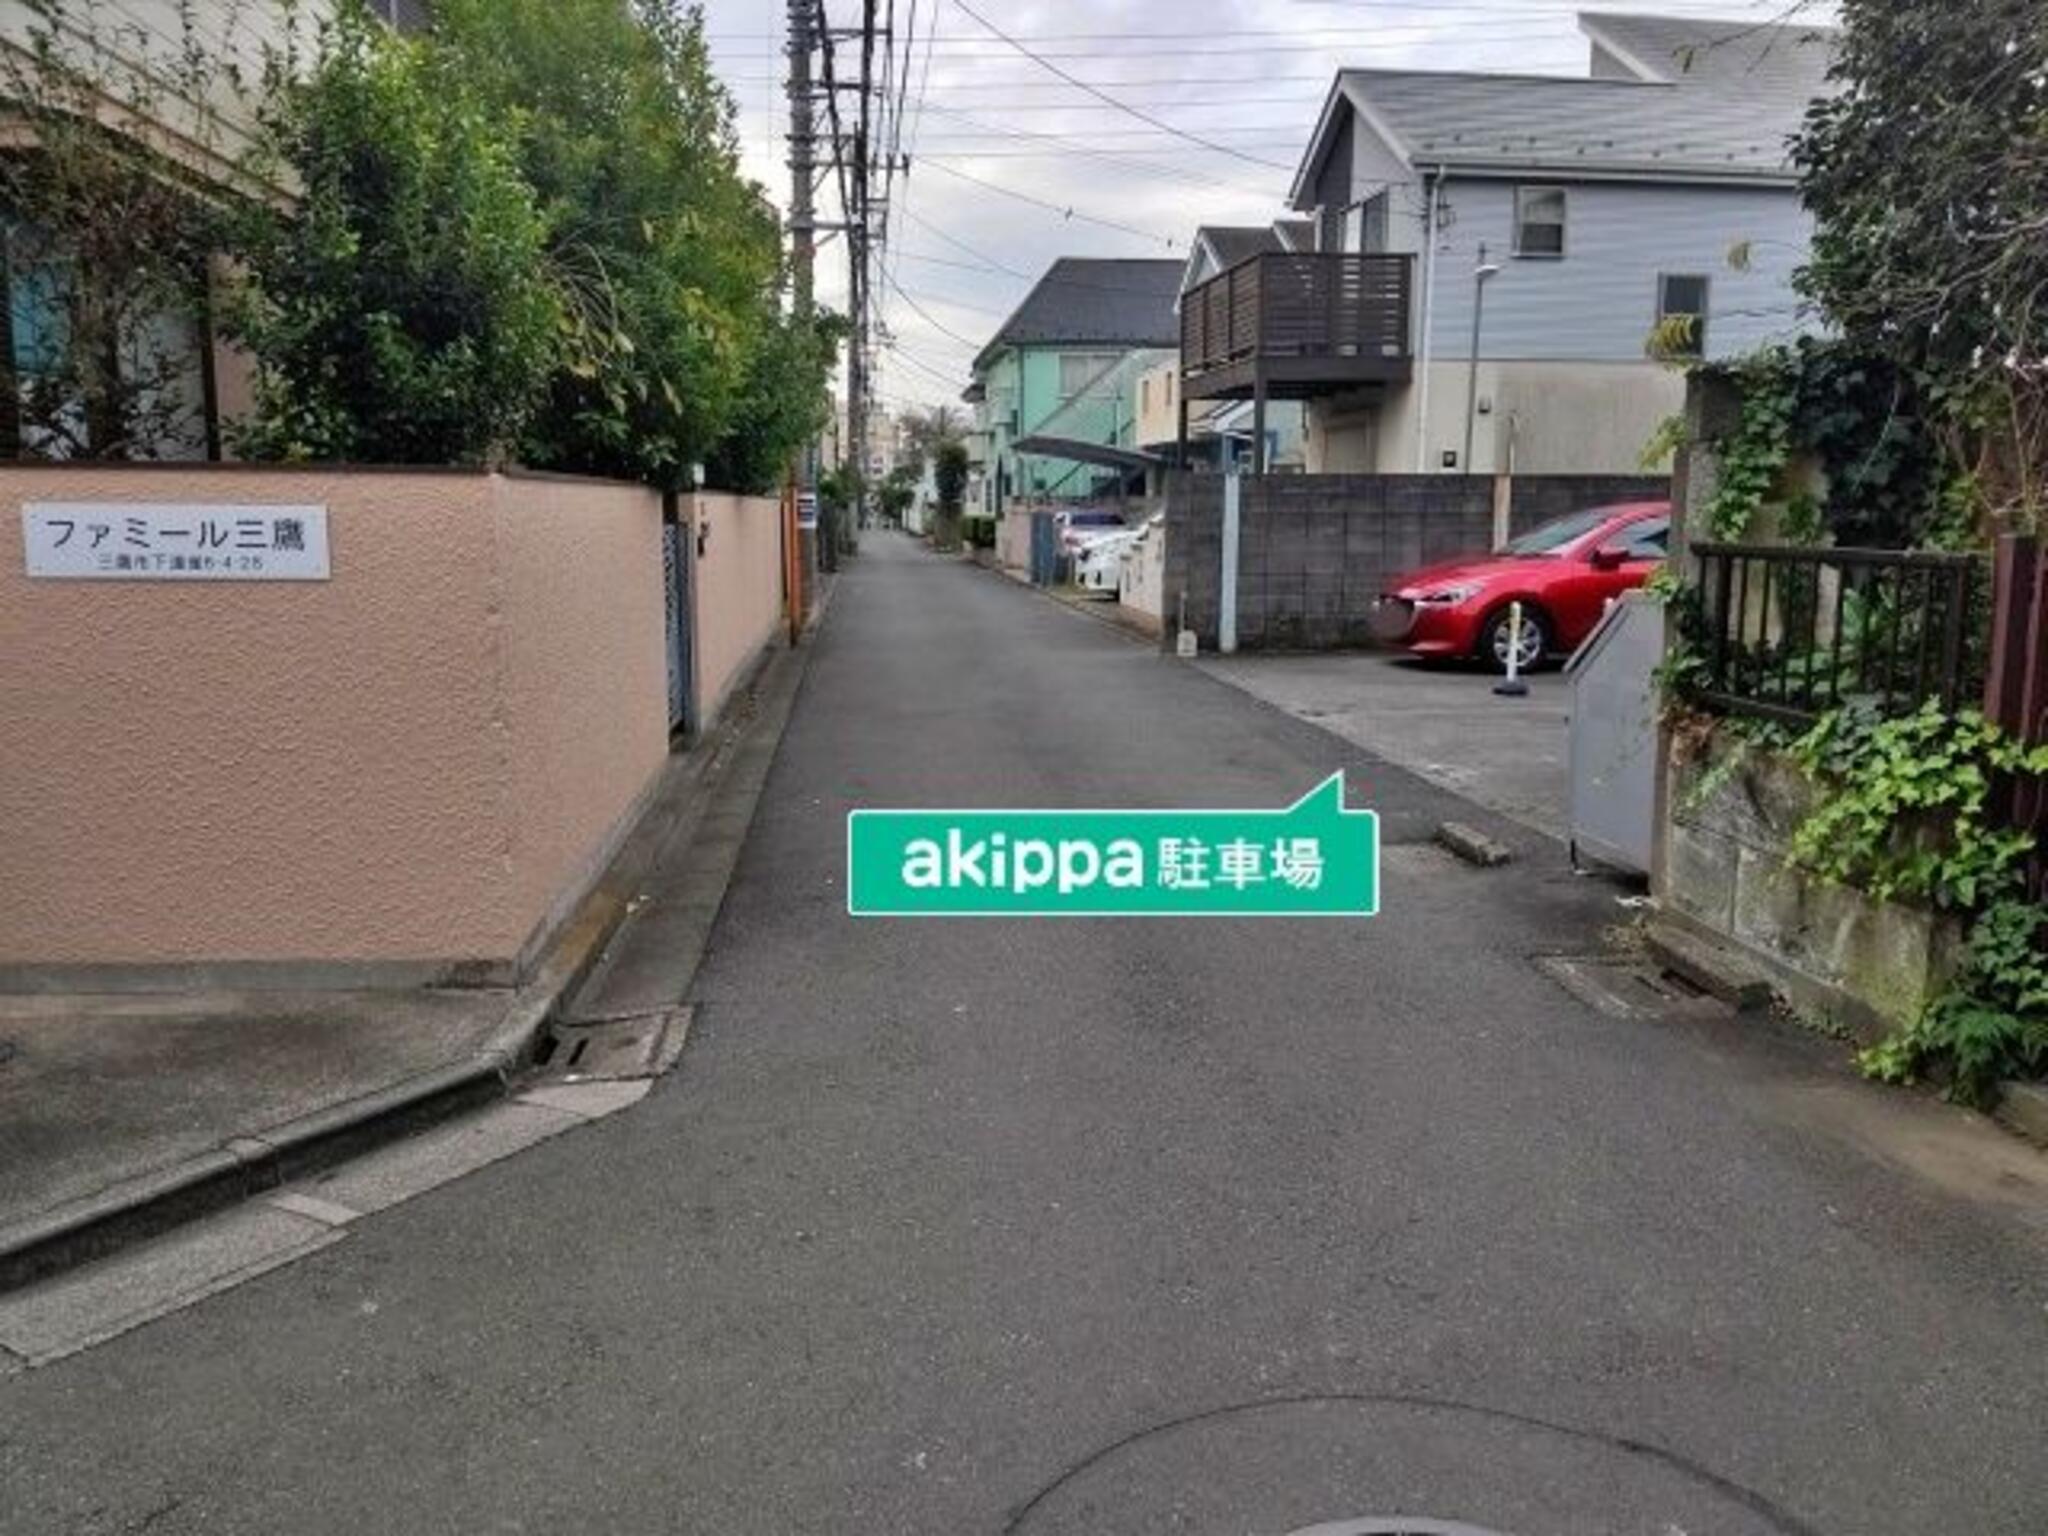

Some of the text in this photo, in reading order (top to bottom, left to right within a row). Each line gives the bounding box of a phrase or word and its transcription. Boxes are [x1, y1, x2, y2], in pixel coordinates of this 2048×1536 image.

[46, 518, 305, 552] ファミール三鷹
